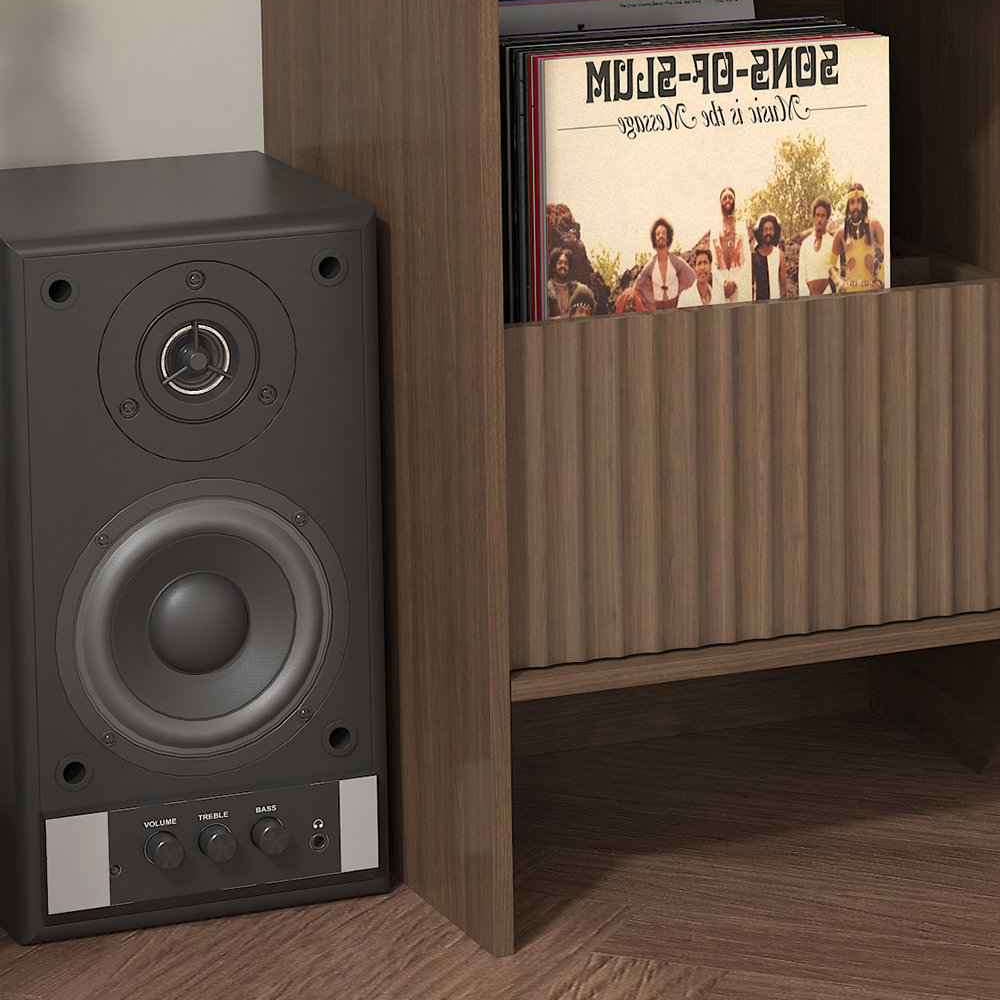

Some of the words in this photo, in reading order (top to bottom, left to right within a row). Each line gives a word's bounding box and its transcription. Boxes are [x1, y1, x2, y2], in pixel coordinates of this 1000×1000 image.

[255, 804, 277, 814] BASS
[198, 810, 229, 822] TREBLE
[143, 817, 178, 829] VOLUME
